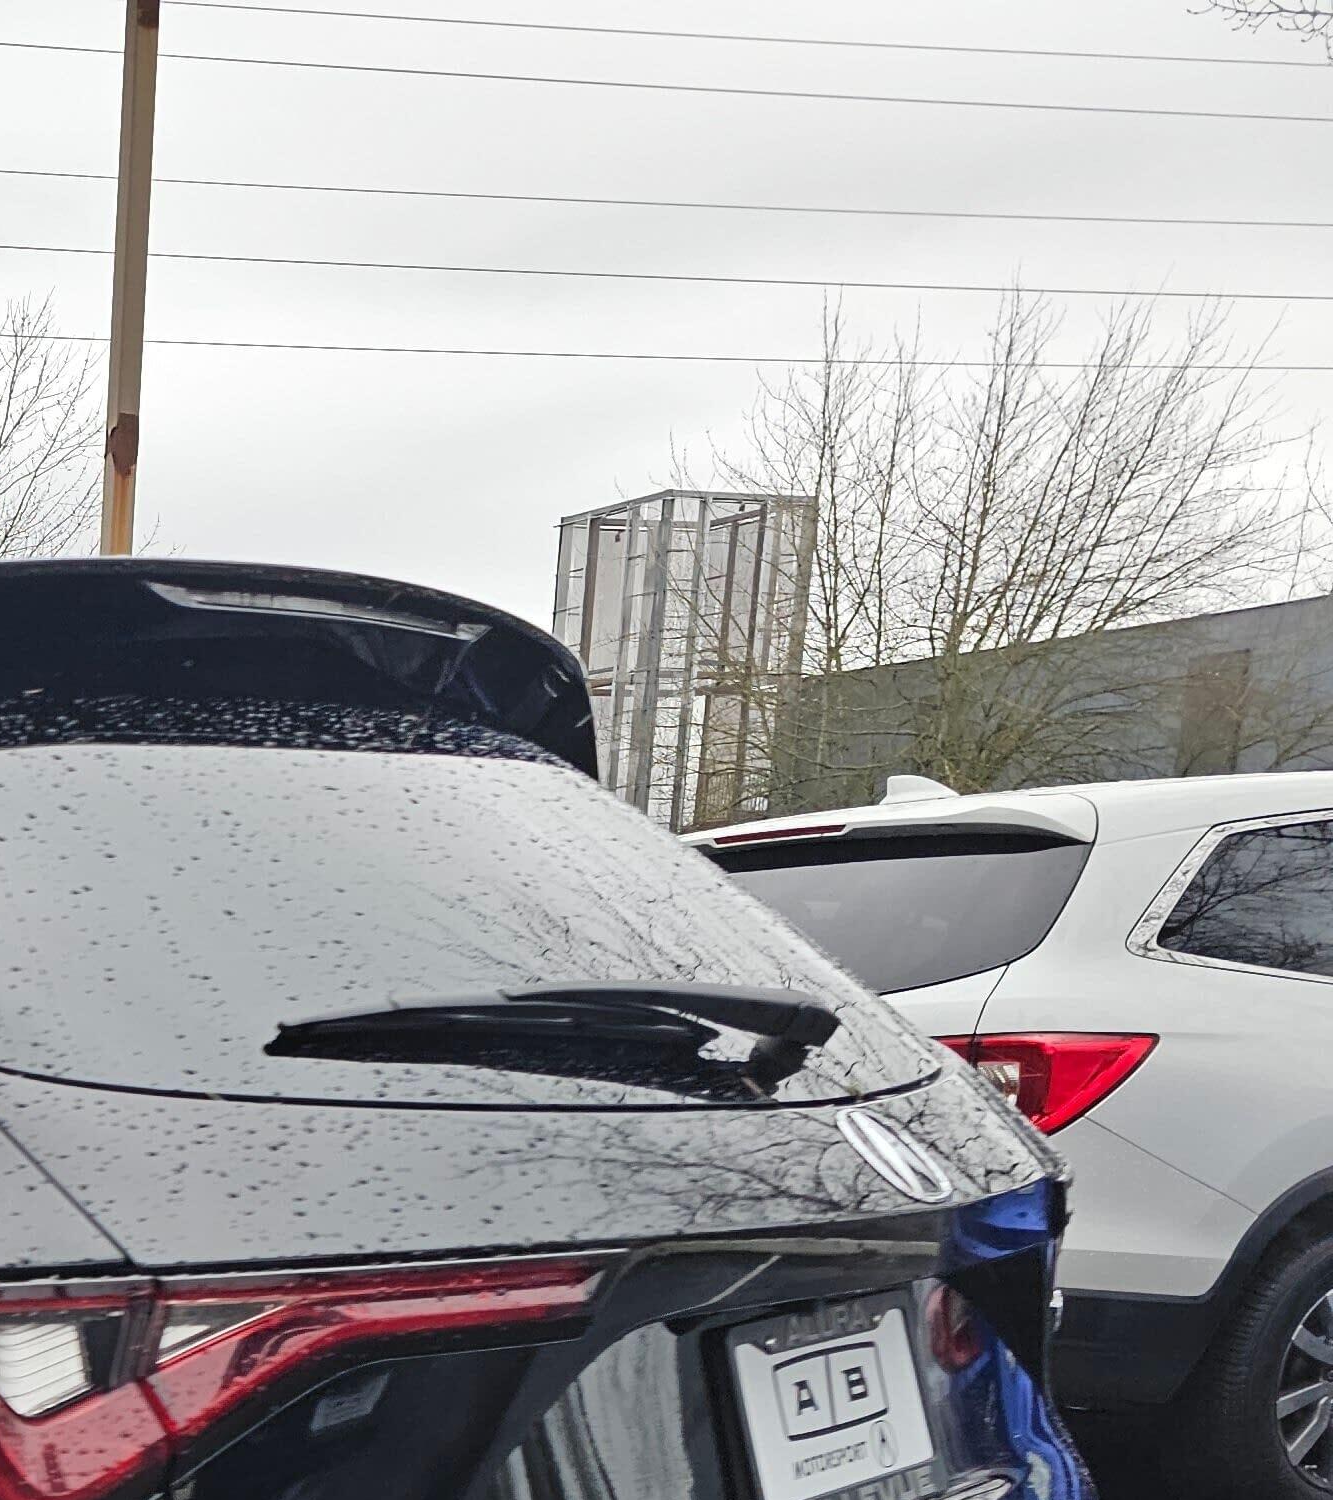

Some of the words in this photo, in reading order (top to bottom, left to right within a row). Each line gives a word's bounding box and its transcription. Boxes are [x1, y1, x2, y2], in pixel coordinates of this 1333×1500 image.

[792, 1379, 820, 1416] A
[841, 1365, 870, 1402] B
[792, 1440, 868, 1480] MOTORSPORT
